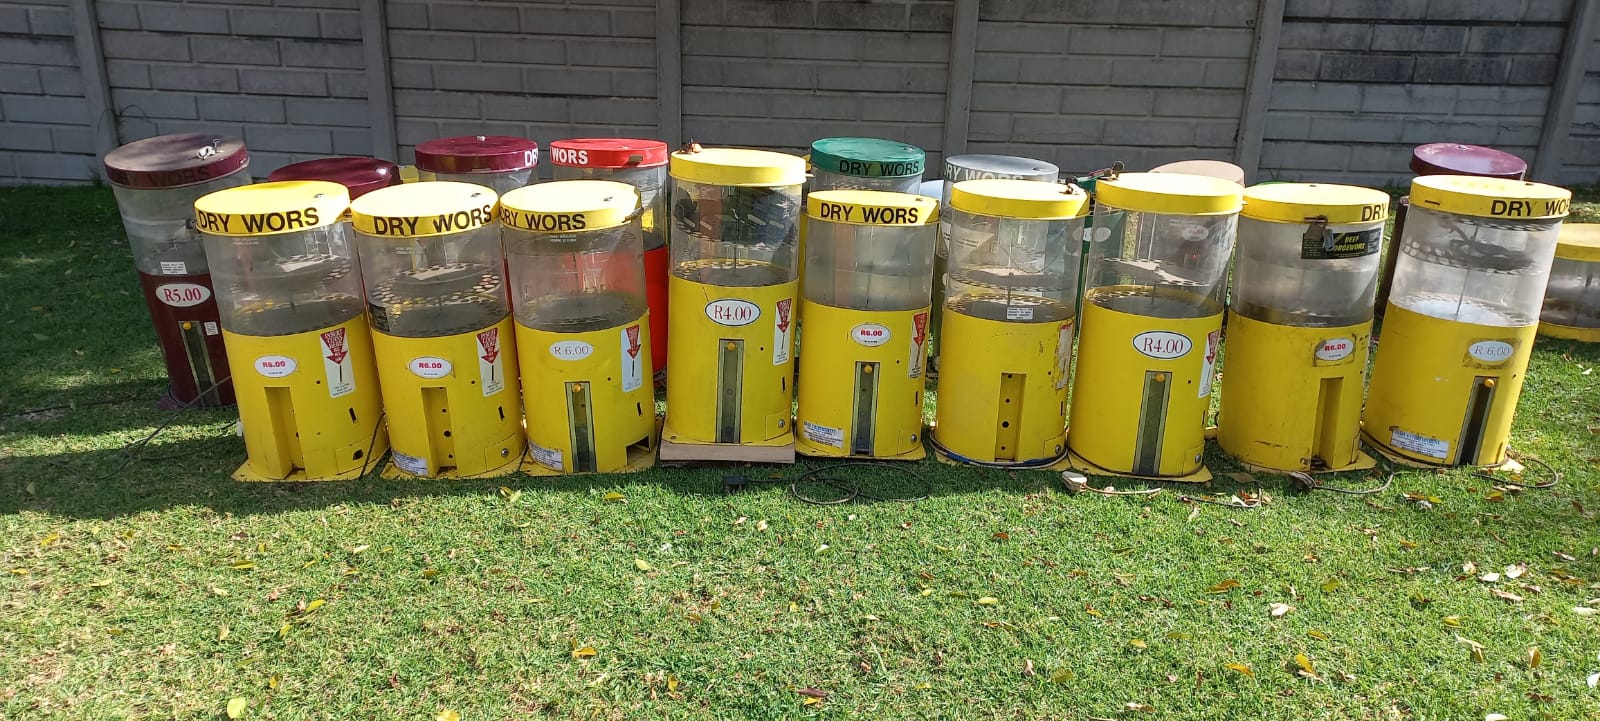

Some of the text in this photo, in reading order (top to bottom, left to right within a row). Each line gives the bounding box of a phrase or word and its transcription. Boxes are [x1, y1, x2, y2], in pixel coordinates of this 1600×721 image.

[524, 148, 539, 167] DR
[551, 147, 588, 165] WORS
[147, 166, 209, 187] WORS
[840, 160, 919, 176] DRY WORS
[821, 202, 918, 224] DRY WORS
[1361, 202, 1387, 222] DRY
[1491, 199, 1570, 216] DRY WO
[198, 206, 319, 233] DRY WORS
[373, 204, 493, 236] DRY WORS
[525, 213, 586, 231] WORS
[163, 287, 202, 302] R5.00
[714, 304, 752, 321] R4.00
[860, 329, 883, 337] R6.00
[554, 345, 589, 356] R 6.00
[1143, 337, 1183, 354] R4.00
[1324, 343, 1347, 352] R6.00
[1475, 345, 1510, 357] R 6.00
[262, 360, 286, 368] R6.00
